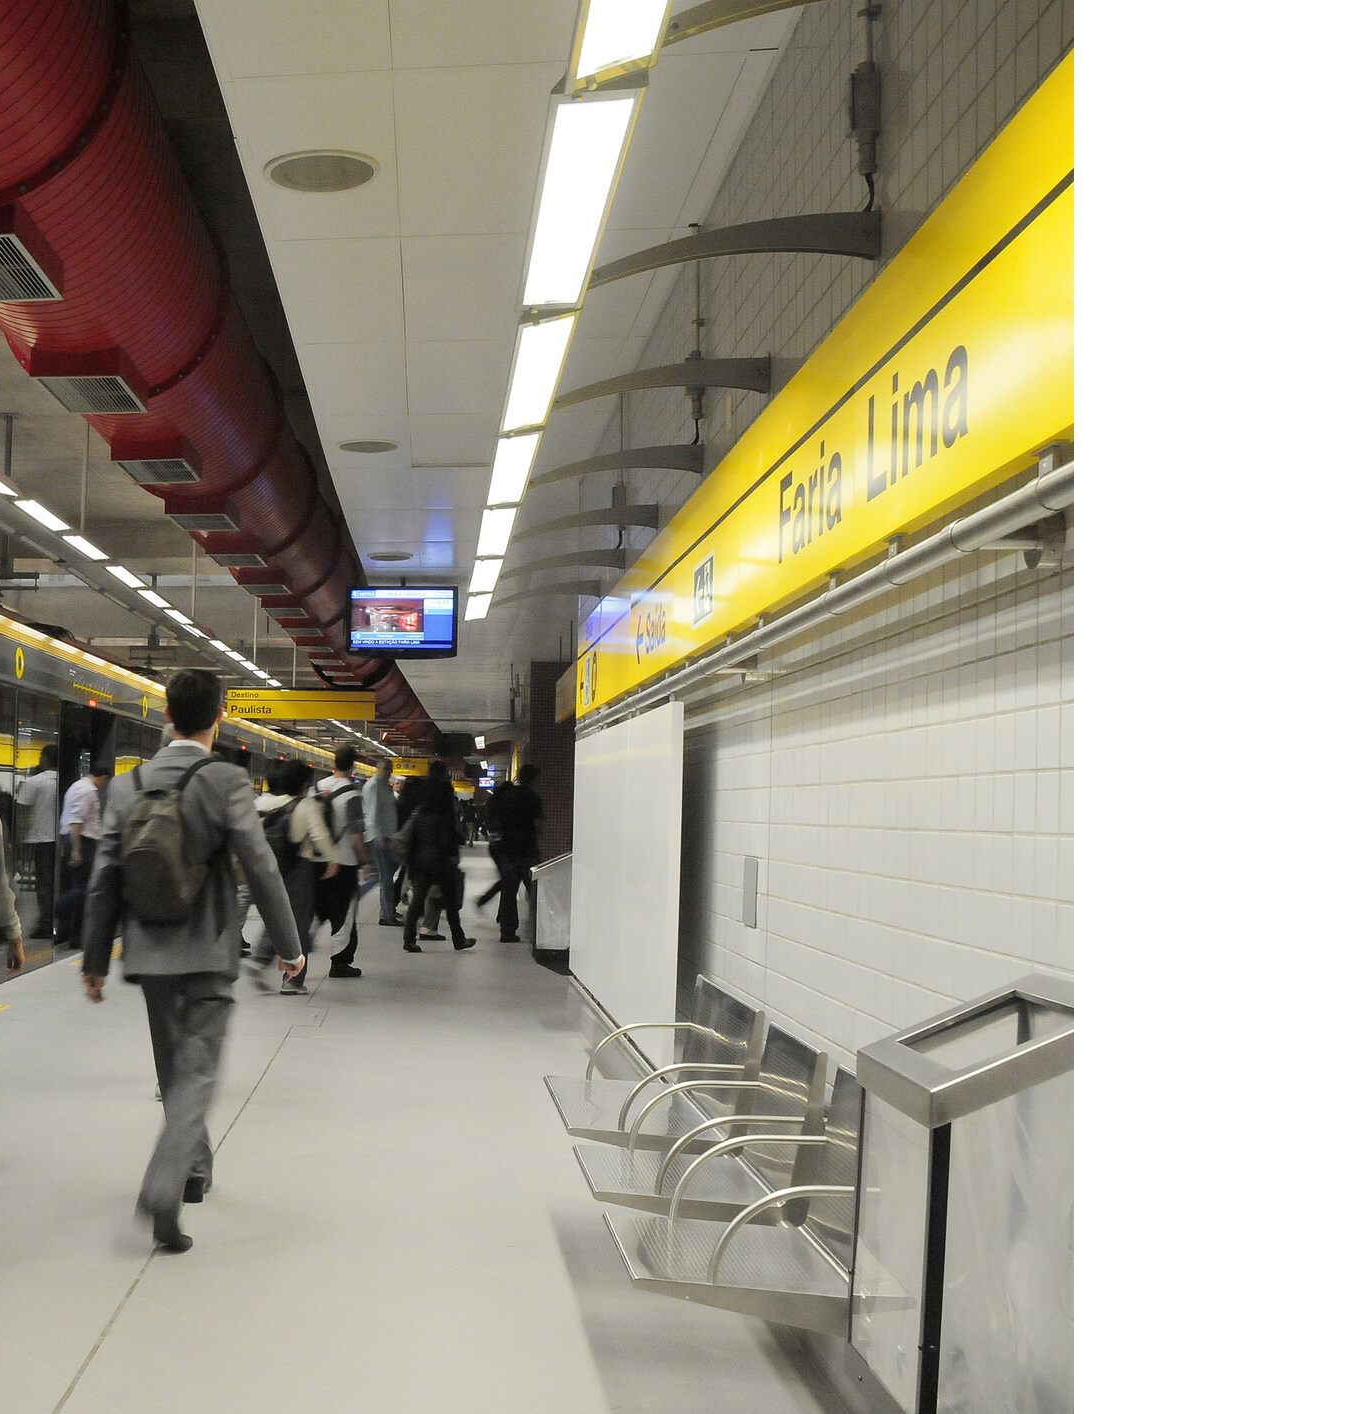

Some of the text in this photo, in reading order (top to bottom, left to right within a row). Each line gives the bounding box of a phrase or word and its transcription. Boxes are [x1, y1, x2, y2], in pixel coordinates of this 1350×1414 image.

[778, 344, 969, 564] Faria Lima
[645, 603, 666, 655] Saída
[230, 705, 272, 714] Paulista
[231, 691, 259, 699] Destino
